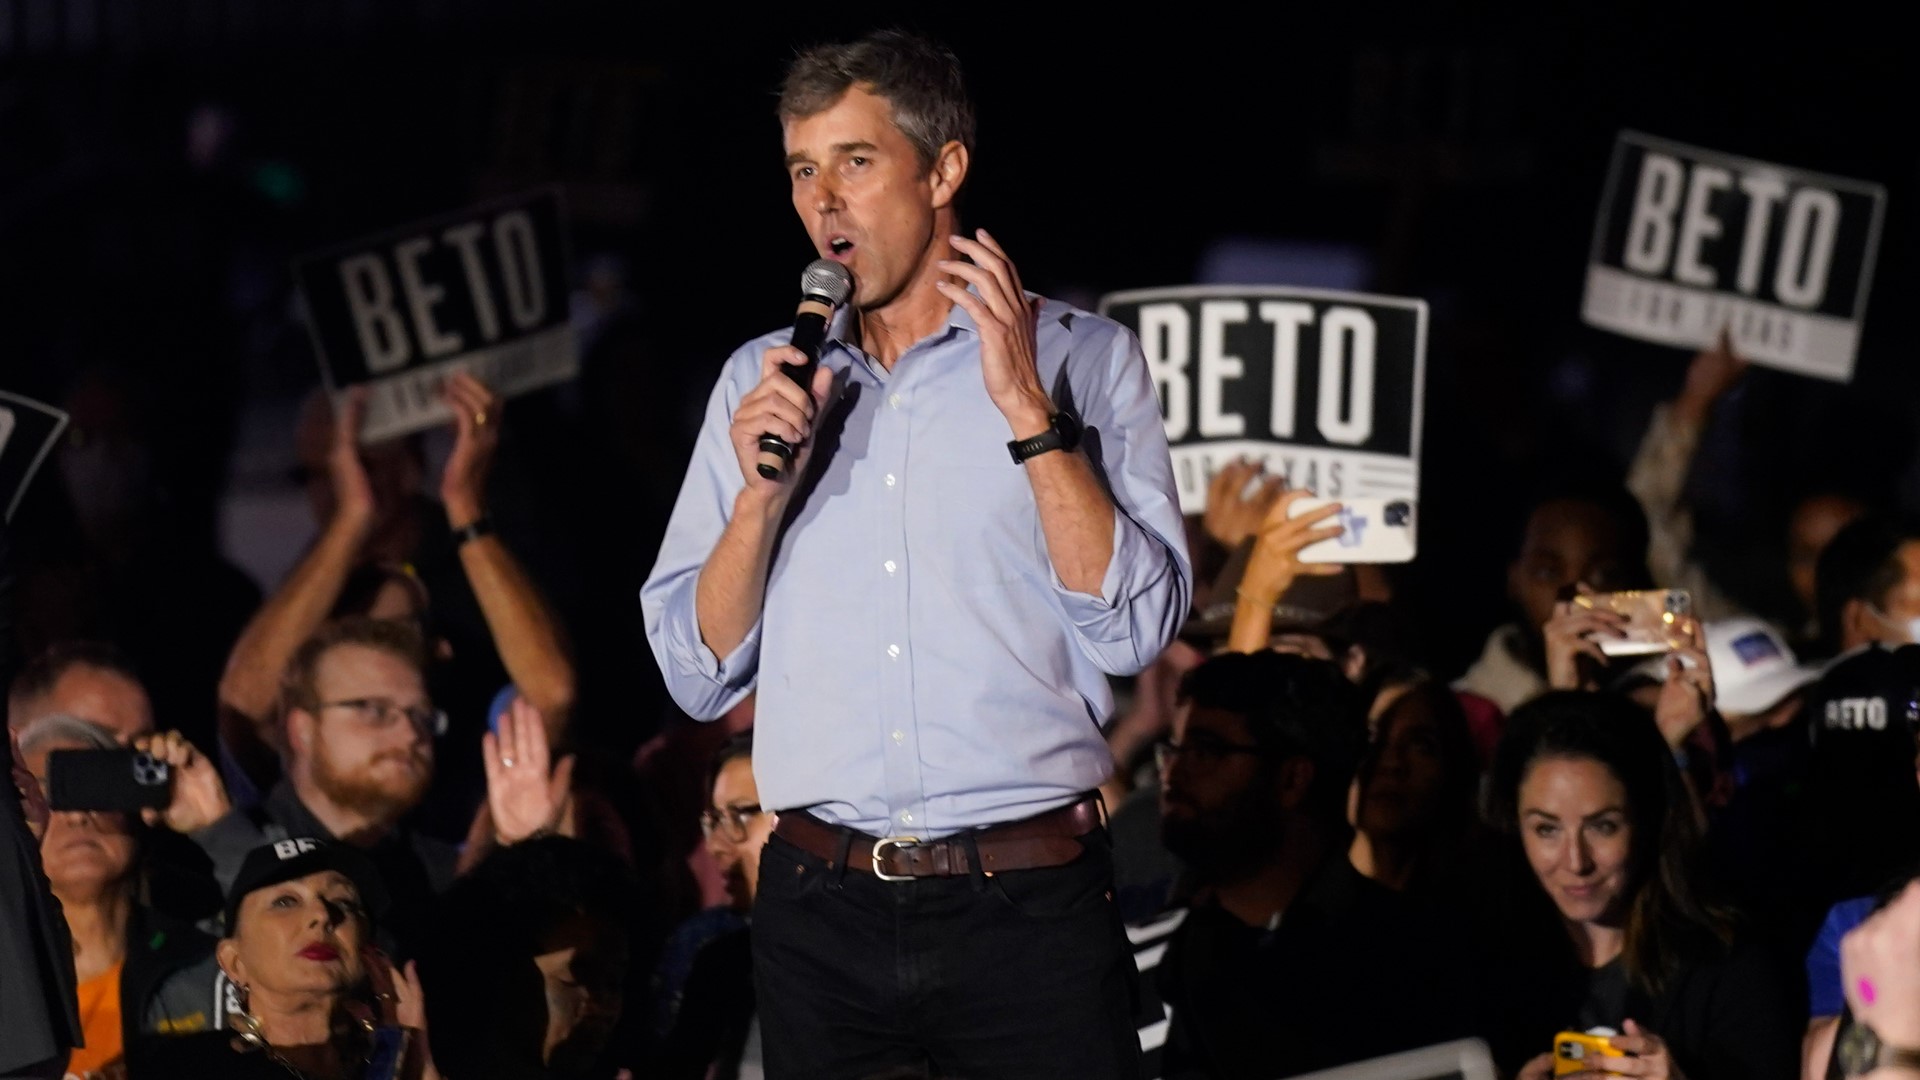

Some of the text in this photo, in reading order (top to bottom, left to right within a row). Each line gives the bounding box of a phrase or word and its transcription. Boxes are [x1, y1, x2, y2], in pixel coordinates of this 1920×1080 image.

[337, 210, 549, 375] BETO
[1623, 152, 1842, 308] BETO
[1138, 301, 1377, 446] BETO
[1824, 696, 1889, 731] BETO
[273, 837, 322, 860] BE
